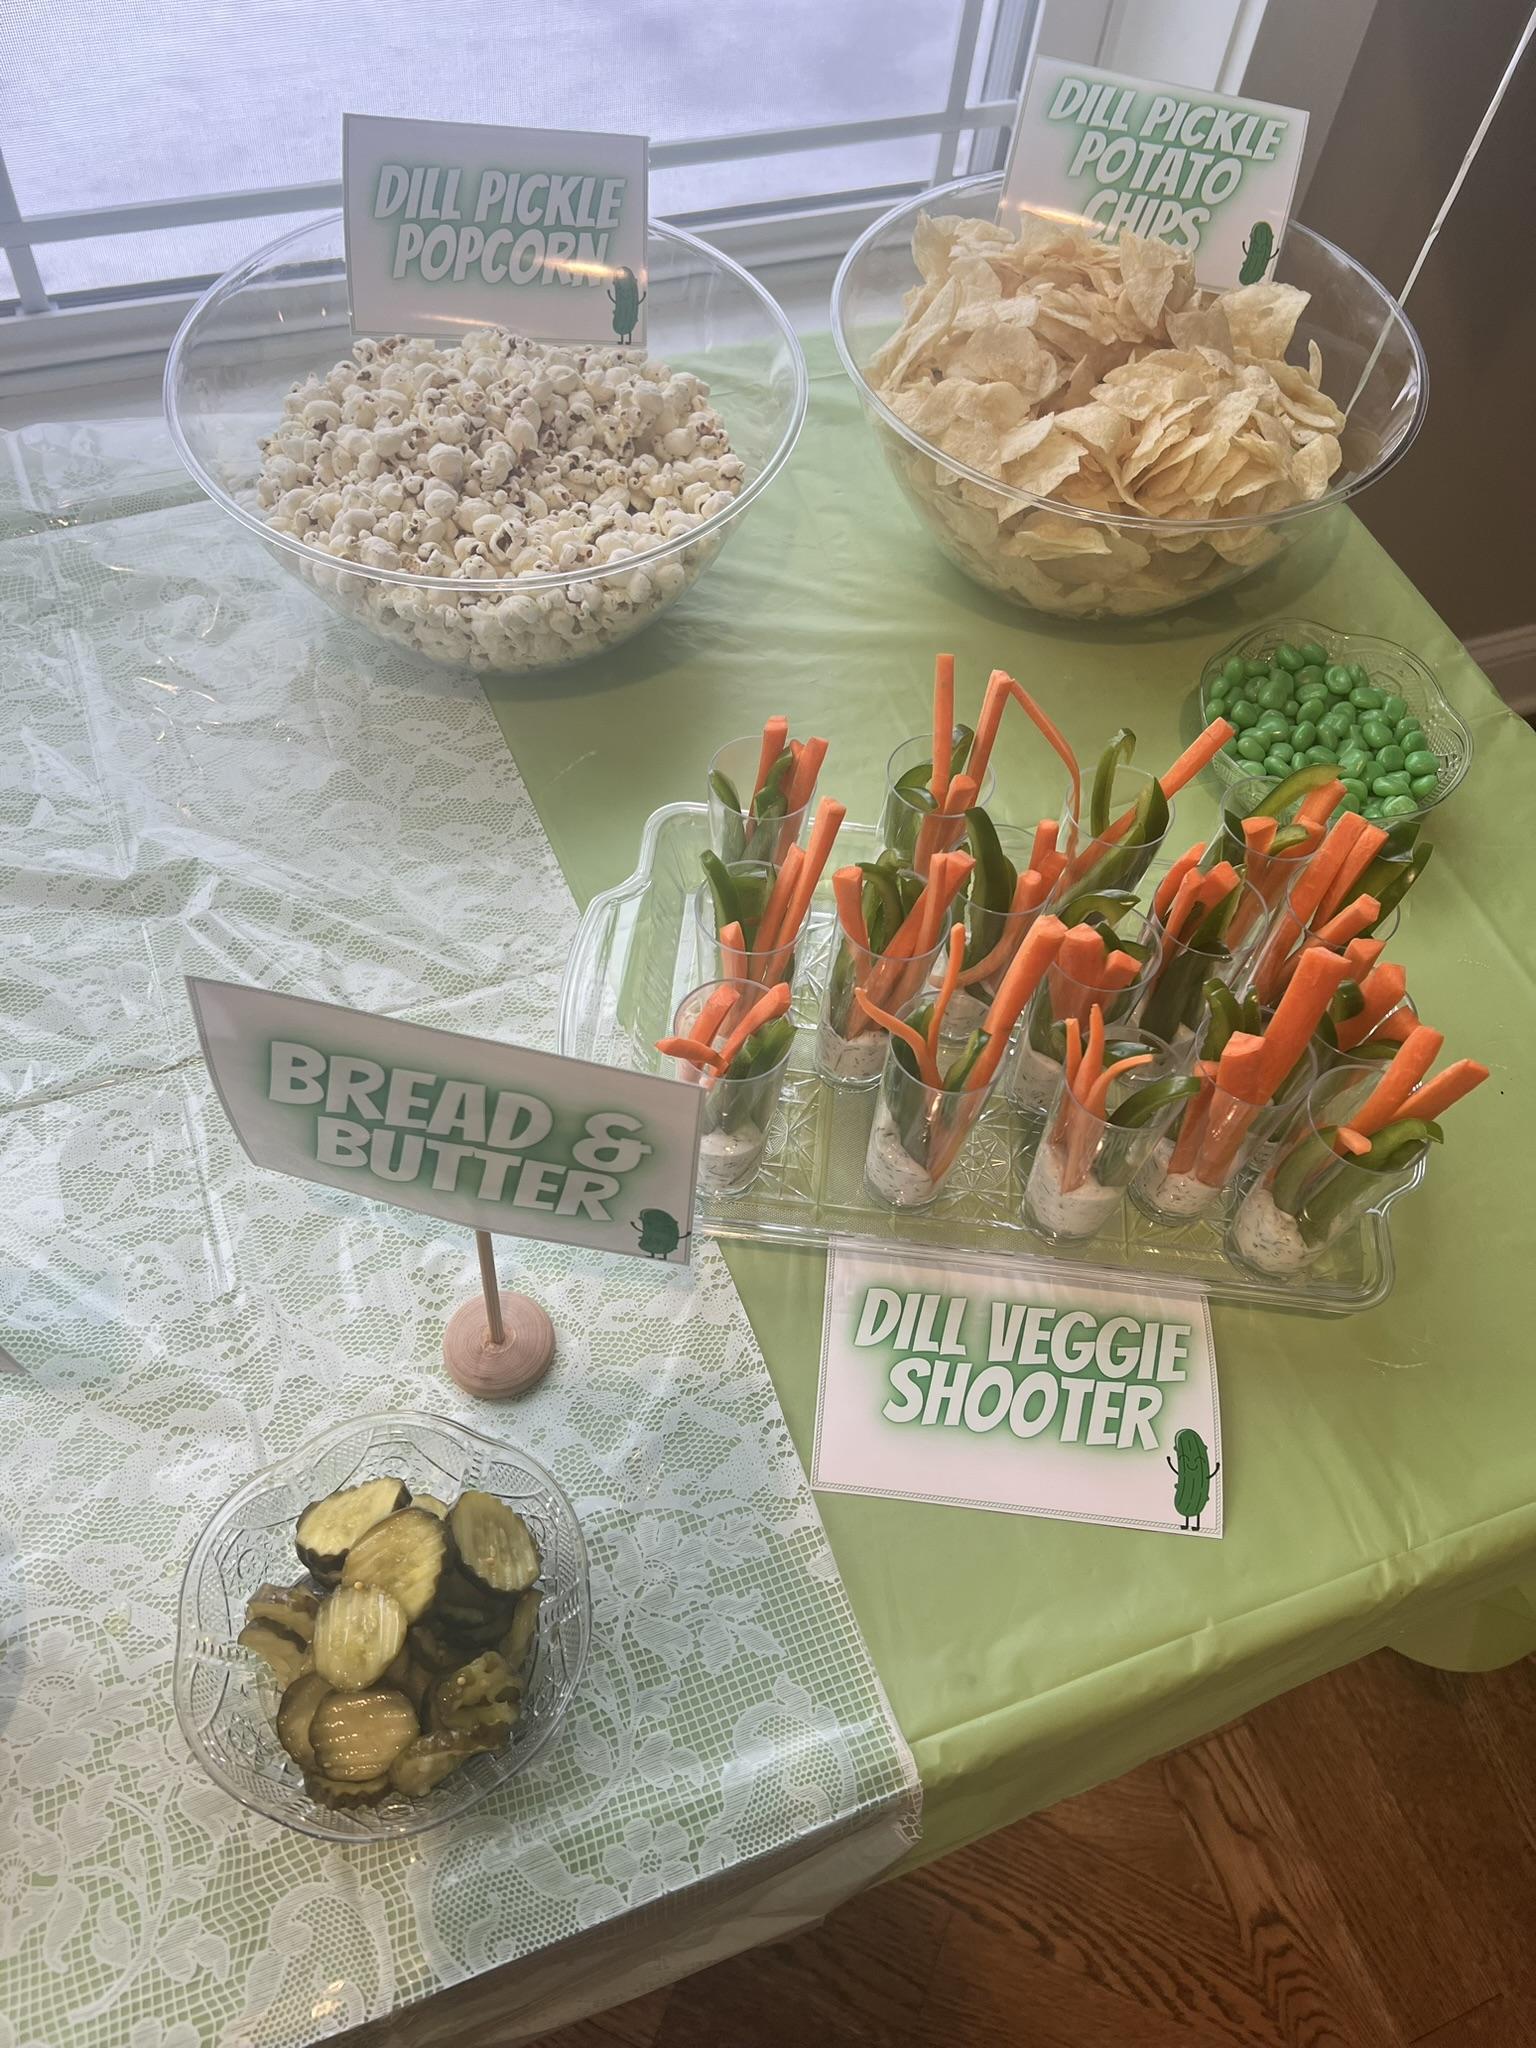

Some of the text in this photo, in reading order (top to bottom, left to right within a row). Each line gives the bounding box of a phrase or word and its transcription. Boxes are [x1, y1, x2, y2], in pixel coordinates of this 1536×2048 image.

[1048, 77, 1288, 161] DILL PICKLE
[374, 164, 626, 229] DILL PICKLE
[1067, 131, 1242, 205] POTATO
[392, 223, 609, 288] POPCORN
[1083, 188, 1211, 252] CHIPS
[268, 1040, 653, 1174] BREAD &
[316, 1116, 621, 1222] BUTTER
[854, 1288, 1192, 1382] DILL VEGGIE
[882, 1357, 1164, 1451] SHOOTER
